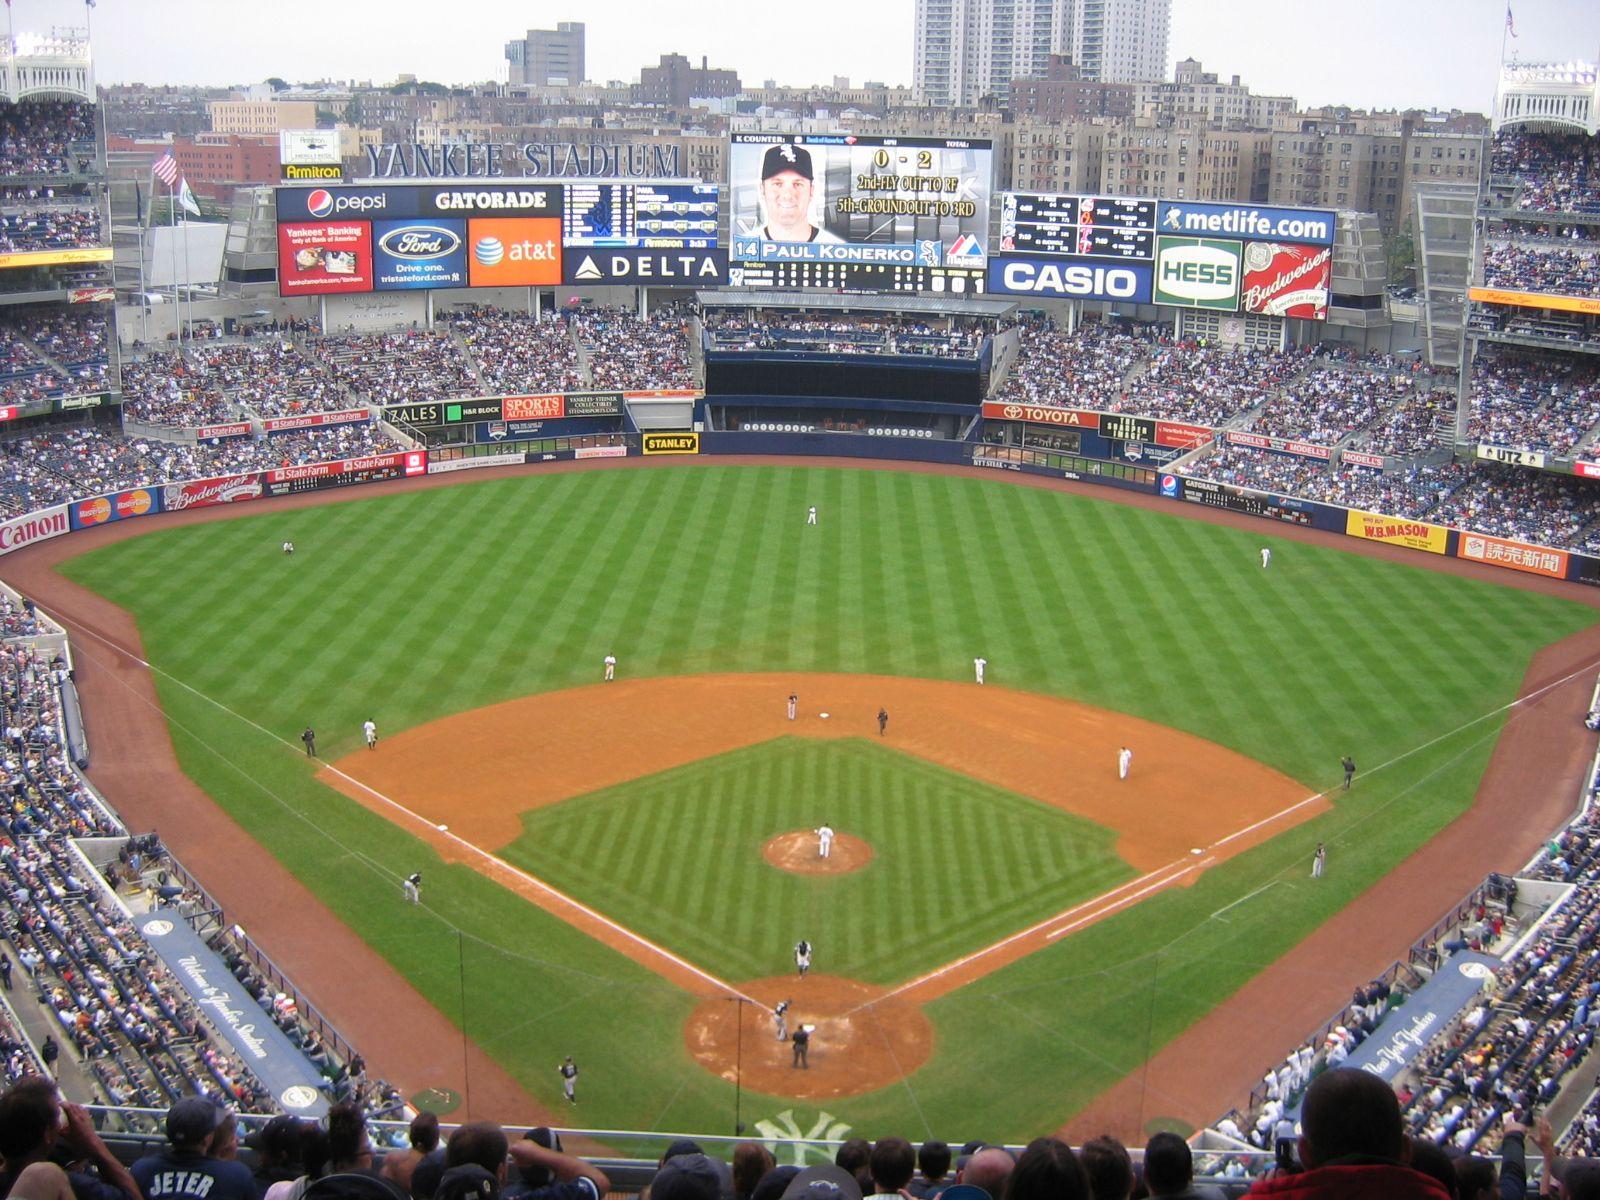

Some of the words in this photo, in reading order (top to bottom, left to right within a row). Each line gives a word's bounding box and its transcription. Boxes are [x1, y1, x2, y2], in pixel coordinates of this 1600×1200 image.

[366, 142, 502, 178] YANKEE
[523, 142, 680, 178] STADIUM
[918, 151, 932, 169] 2
[287, 165, 341, 179] Armitron
[857, 175, 899, 191] 2nd-FLY
[901, 176, 925, 192] OUT
[927, 177, 942, 192] TO
[944, 177, 958, 193] RF
[336, 193, 387, 213] pepsi
[435, 191, 547, 210] GATORADE
[934, 201, 949, 216] TO
[951, 201, 976, 217] 3RD
[286, 227, 323, 238] Yankees
[327, 226, 362, 237] Banking
[1185, 209, 1327, 239] metlife.com
[398, 233, 442, 253] Ford
[509, 239, 556, 261] at&t
[736, 242, 757, 256] 14
[762, 246, 816, 258] PAUL
[819, 246, 915, 261] KONERKO
[396, 265, 422, 273] Drive
[611, 256, 719, 277] DELTA
[946, 255, 984, 267] Majestic
[1003, 262, 1137, 298] CASIO
[1164, 261, 1233, 285] HESS
[1242, 248, 1331, 312] Budweiser
[975, 278, 984, 294] 1
[463, 407, 477, 415] H&R
[478, 406, 500, 414] BLOCK
[506, 397, 560, 411] SPORTS
[331, 414, 346, 422] State
[347, 412, 361, 420] Farm
[391, 406, 437, 423] ZALES
[1025, 408, 1080, 425] TOYOTA
[1121, 417, 1135, 425] THE
[210, 427, 228, 436] State
[229, 425, 246, 434] Farm
[279, 420, 295, 428] State
[649, 435, 694, 449] STANLEY
[1230, 433, 1266, 446] MODELL'S
[1290, 444, 1327, 456] MODELL'S
[1497, 449, 1522, 464] UTZ
[354, 459, 374, 470] State
[375, 456, 395, 466] Farm
[1344, 453, 1383, 466] MODELL'S
[285, 469, 307, 480] State
[308, 465, 329, 476] Farm
[169, 475, 249, 510] Budweiser
[79, 504, 111, 518] MasterCard
[117, 498, 150, 510] MasterCard
[0, 511, 66, 550] Canon
[1486, 541, 1560, 573] 読売新聞
[150, 1171, 215, 1200] JETER
